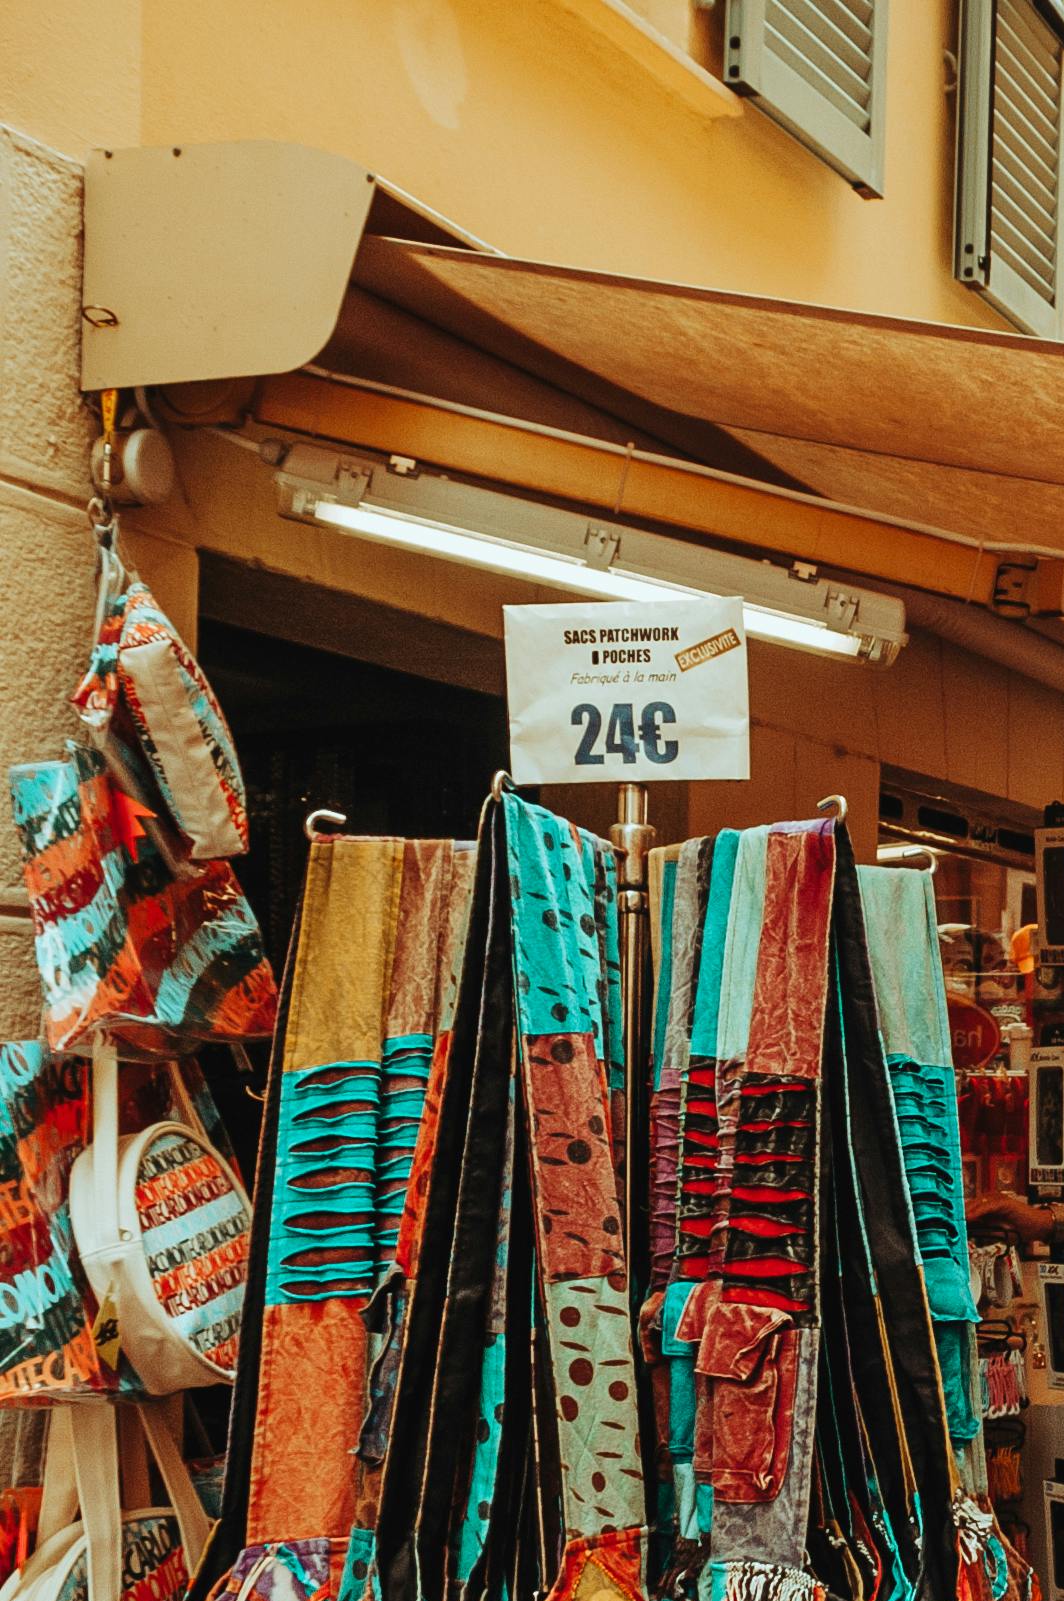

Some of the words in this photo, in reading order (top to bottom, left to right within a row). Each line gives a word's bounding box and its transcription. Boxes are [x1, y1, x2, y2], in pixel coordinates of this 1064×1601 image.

[563, 629, 597, 645] SACS
[600, 626, 680, 643] PATCHWORK
[602, 648, 651, 664] POCHES
[570, 671, 619, 687] Fabriqué
[622, 671, 630, 683] à
[633, 671, 645, 683] la
[648, 671, 677, 683] main
[570, 701, 679, 766] 24€
